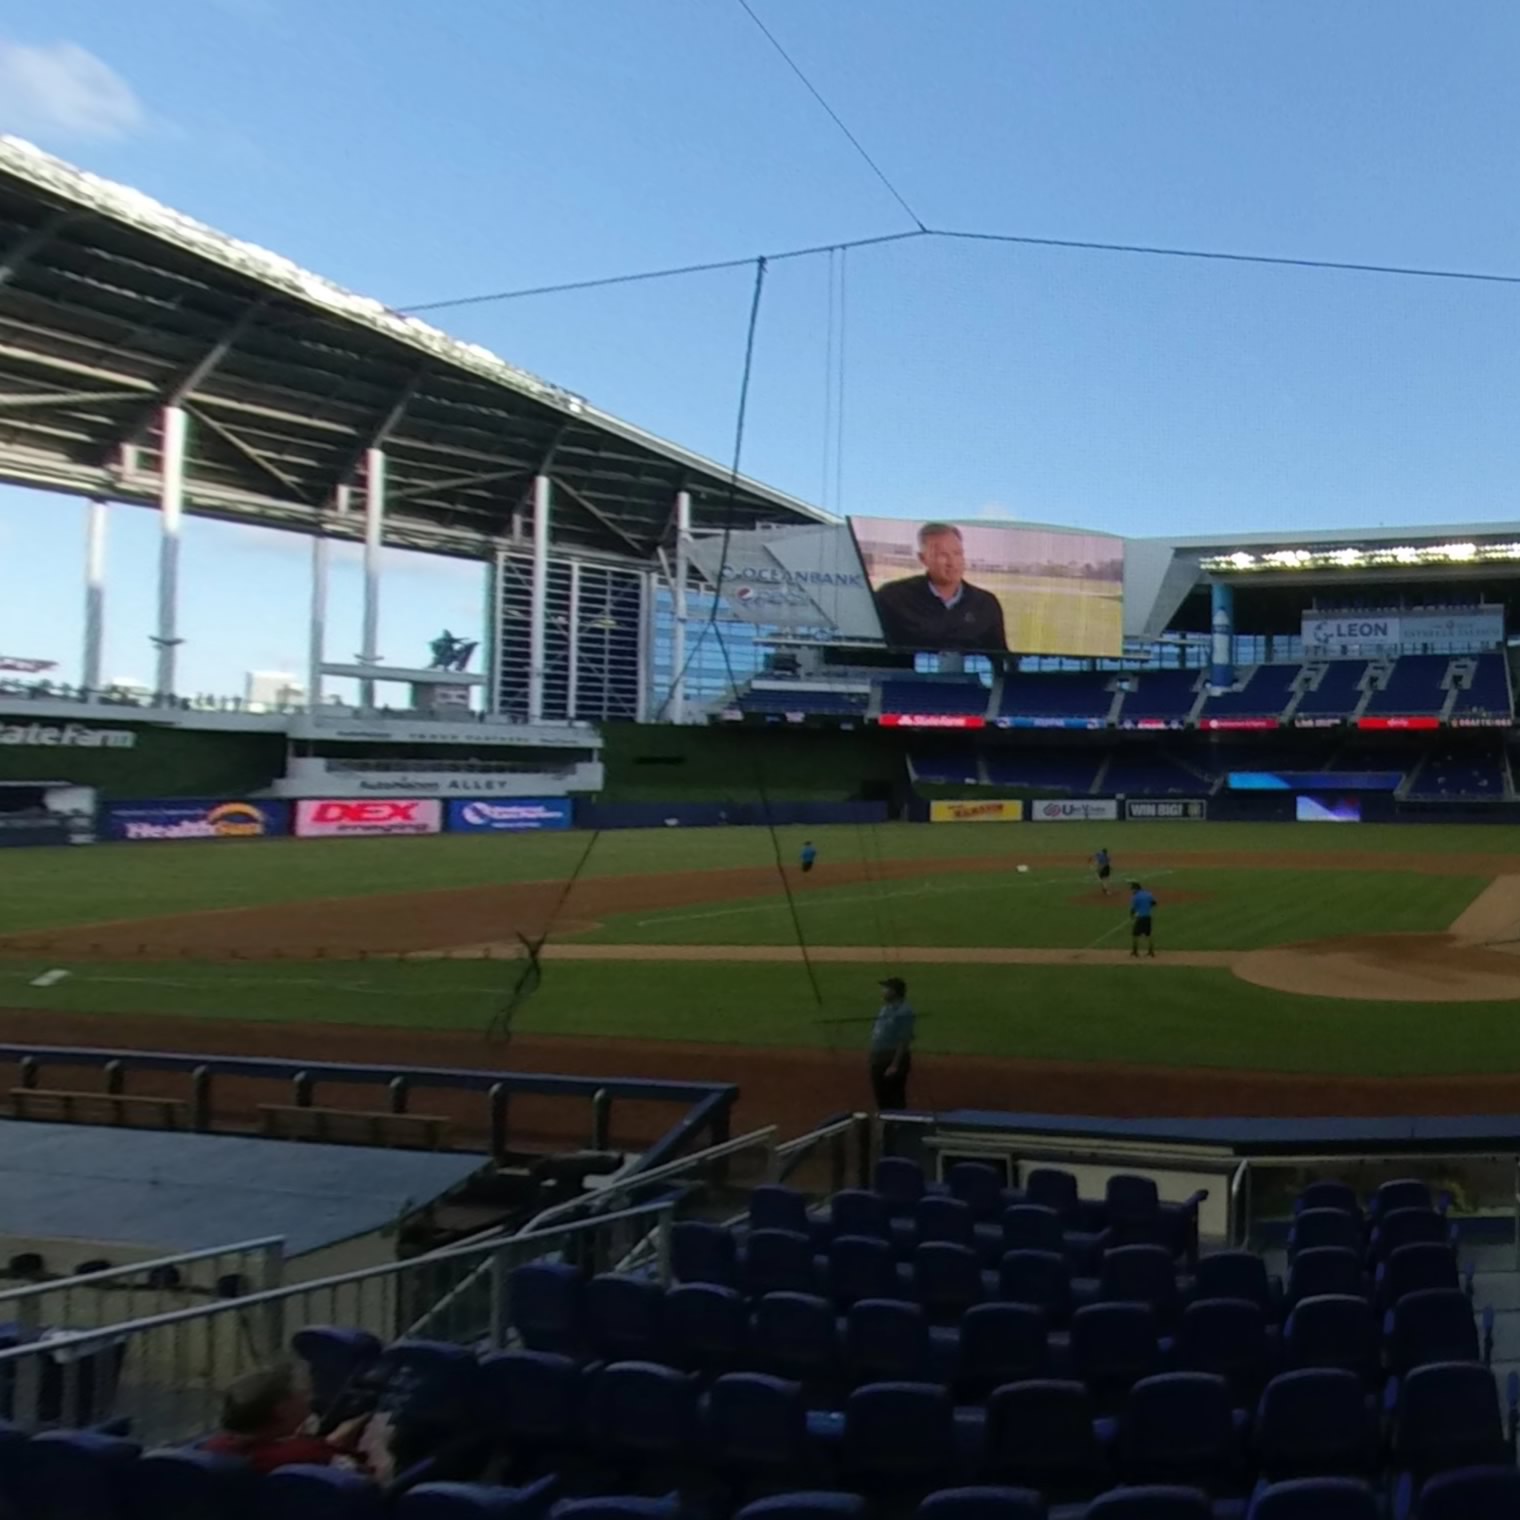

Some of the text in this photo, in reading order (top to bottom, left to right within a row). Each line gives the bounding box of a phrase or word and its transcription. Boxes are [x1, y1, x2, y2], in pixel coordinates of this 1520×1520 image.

[1336, 623, 1388, 638] LEON
[449, 779, 507, 790] ALLEY
[311, 803, 421, 823] DEX
[1131, 803, 1183, 817] WIN BIG!
